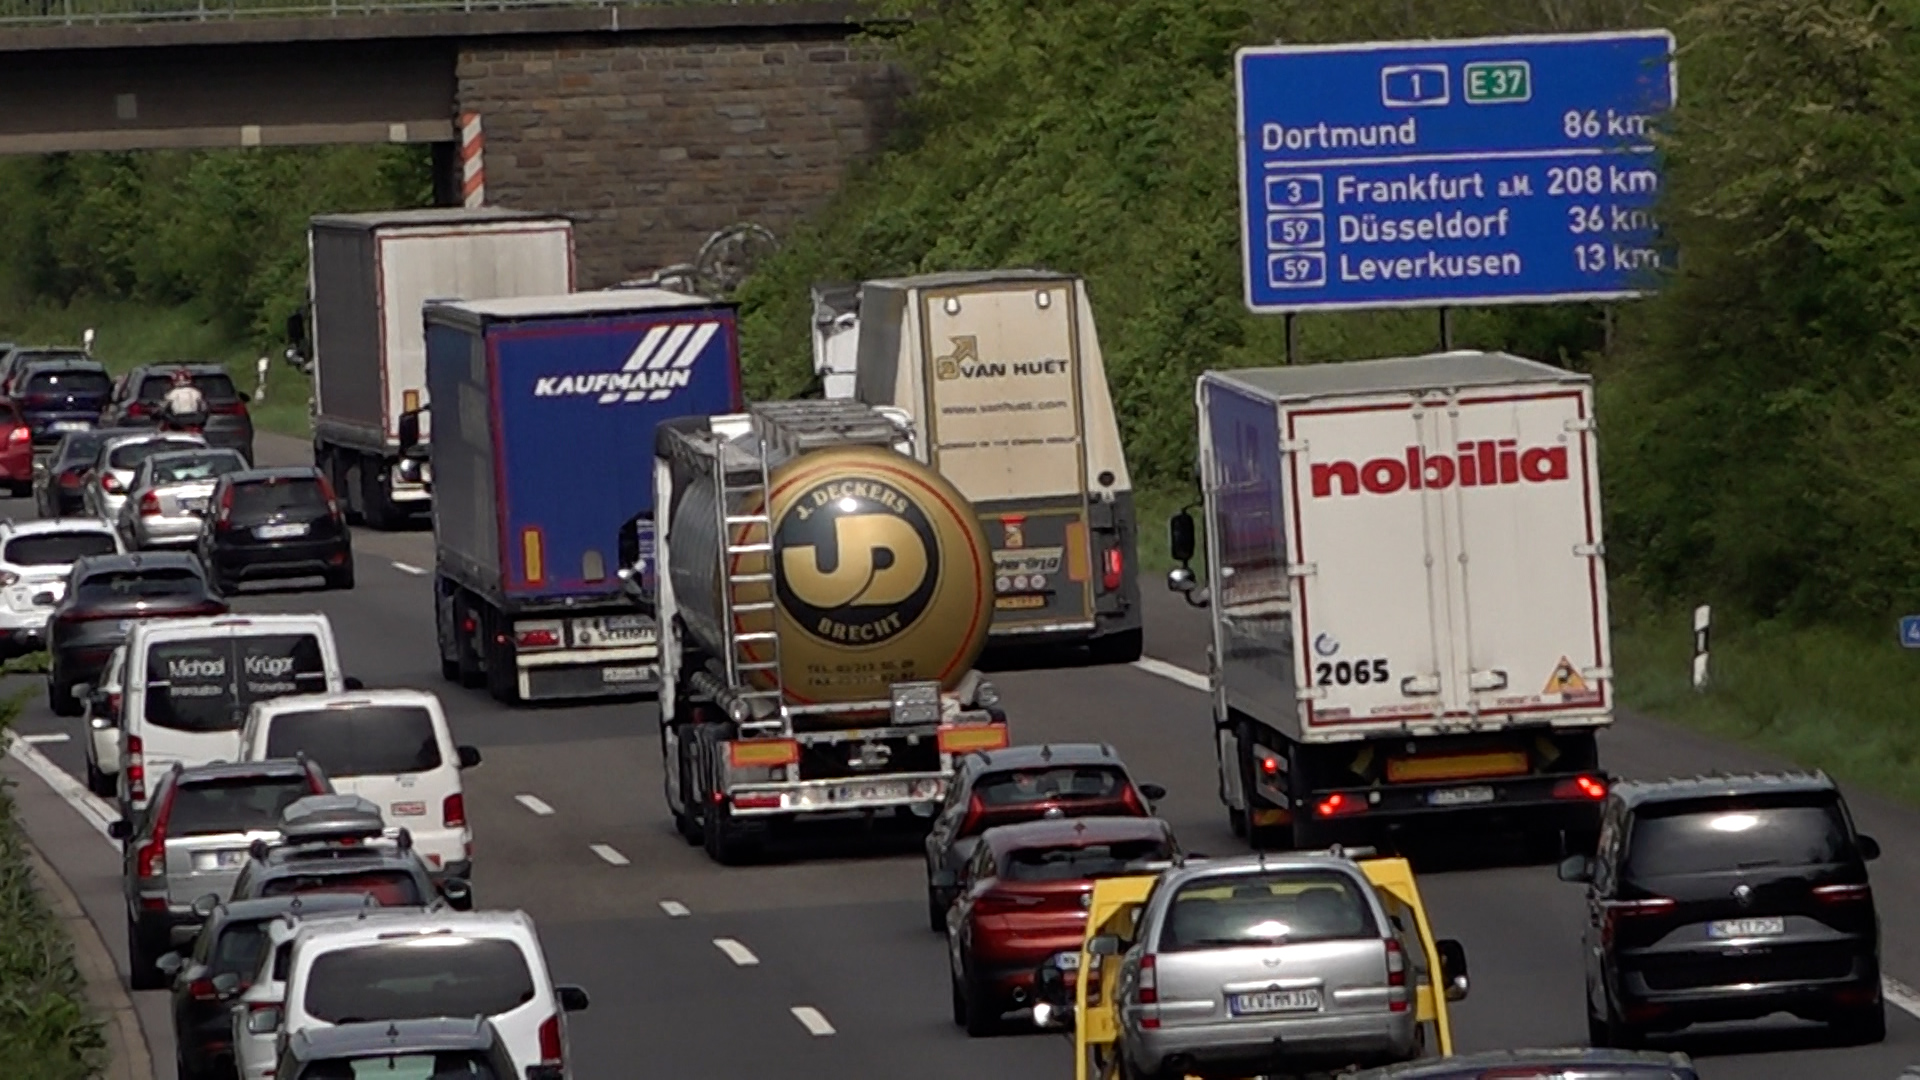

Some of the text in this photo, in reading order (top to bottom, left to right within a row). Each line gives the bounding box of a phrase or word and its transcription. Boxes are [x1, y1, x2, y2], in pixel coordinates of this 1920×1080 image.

[1410, 74, 1421, 98] 1
[1263, 117, 1416, 151] Dortmund
[1564, 110, 1601, 138] 86
[1287, 181, 1302, 203] 3
[1338, 172, 1484, 204] Frankfurt
[1547, 165, 1602, 195] 208
[1610, 165, 1657, 194] km
[1282, 221, 1309, 242] 59
[1339, 207, 1509, 243] Düsseldorf
[1568, 205, 1604, 234] 36
[1283, 259, 1311, 281] 59
[1341, 250, 1521, 282] Leverkusen
[1575, 243, 1606, 272] 13
[535, 369, 692, 396] KAUFMANN
[961, 359, 1069, 379] VAN HUET
[1310, 439, 1569, 498] nobilia
[812, 481, 909, 514] DECKERS
[817, 611, 902, 642] BRECHT
[1316, 659, 1389, 687] 2065
